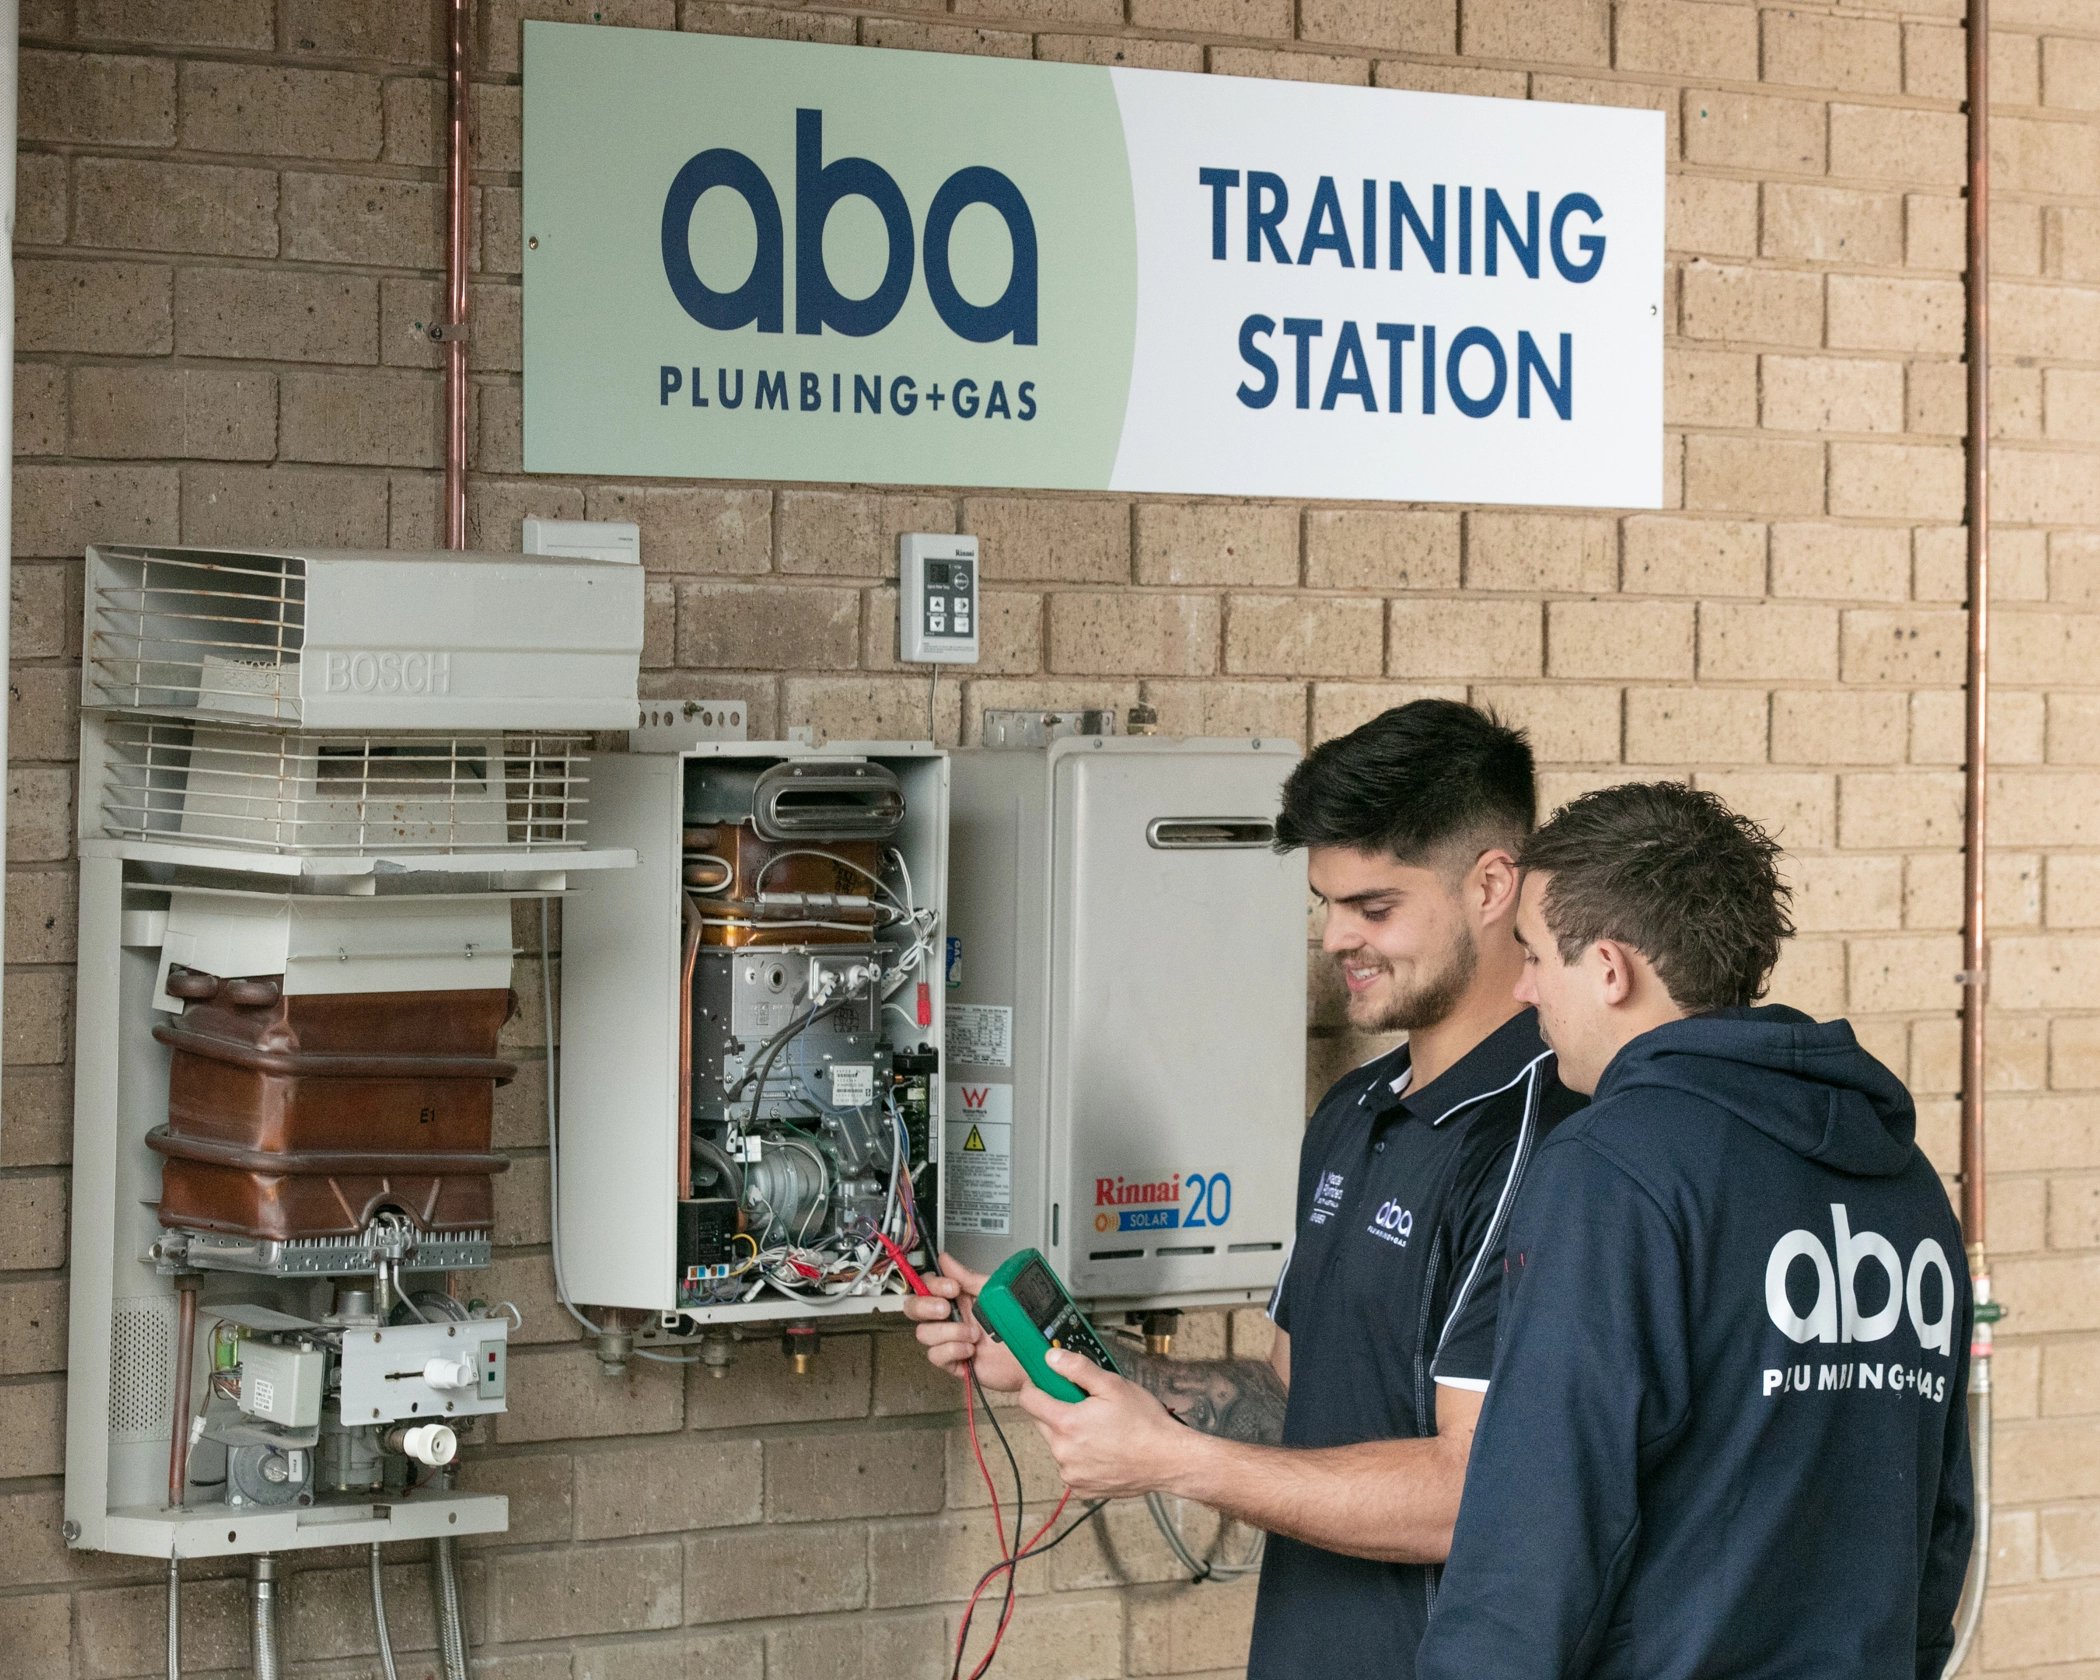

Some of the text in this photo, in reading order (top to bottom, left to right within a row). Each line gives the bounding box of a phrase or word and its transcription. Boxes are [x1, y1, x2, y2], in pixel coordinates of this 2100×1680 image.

[661, 108, 1038, 346] aba
[1200, 168, 1605, 283] TRAINING
[661, 366, 1037, 422] PLUMBING+GAS
[1237, 314, 1571, 420] STATION
[326, 652, 451, 693] BOSCH
[420, 1107, 435, 1124] E1
[1095, 1172, 1231, 1228] Rinnai 20
[1130, 1212, 1169, 1228] SOLAR
[1375, 1198, 1413, 1238] aba
[1765, 1203, 1954, 1357] aba
